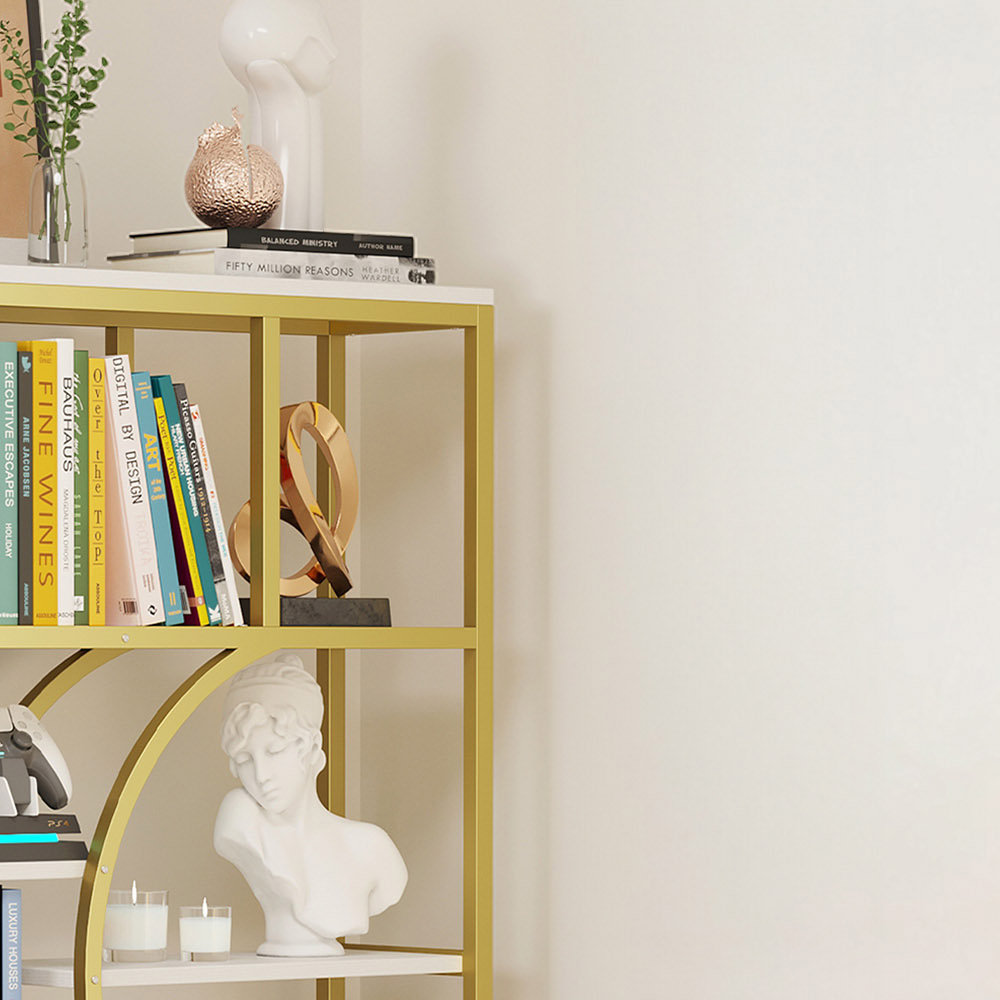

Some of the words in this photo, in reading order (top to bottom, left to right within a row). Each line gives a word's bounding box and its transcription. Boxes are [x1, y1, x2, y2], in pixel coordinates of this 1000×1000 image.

[260, 236, 299, 246] BALANCED
[301, 238, 338, 248] MINISTRY
[357, 242, 383, 250] AUTHOR
[226, 261, 252, 272] FIFTY
[256, 263, 300, 275] MILLION
[305, 266, 354, 277] REASONS
[361, 266, 399, 274] HEATHER
[361, 273, 399, 283] WARDELL
[5, 362, 14, 438] EXECUTIVE
[93, 368, 102, 429] Over
[113, 357, 130, 416] DIGITAL
[39, 381, 53, 456] FINE
[63, 377, 72, 472] BAUHAUS
[122, 425, 134, 441] BY
[174, 423, 184, 444] NEW
[144, 433, 160, 472] ART
[178, 444, 191, 476] URBAN
[180, 398, 194, 439] Picasso
[189, 440, 203, 483] Guitars
[5, 443, 14, 507] ESCAPES
[93, 450, 102, 493] the
[125, 451, 143, 504] DESIGN
[186, 477, 199, 517] HOUSING
[39, 474, 53, 586] WINES
[93, 510, 102, 561] Top
[47, 820, 69, 828] PS4
[8, 902, 18, 944] LUXURY
[8, 947, 18, 990] HOUSES
